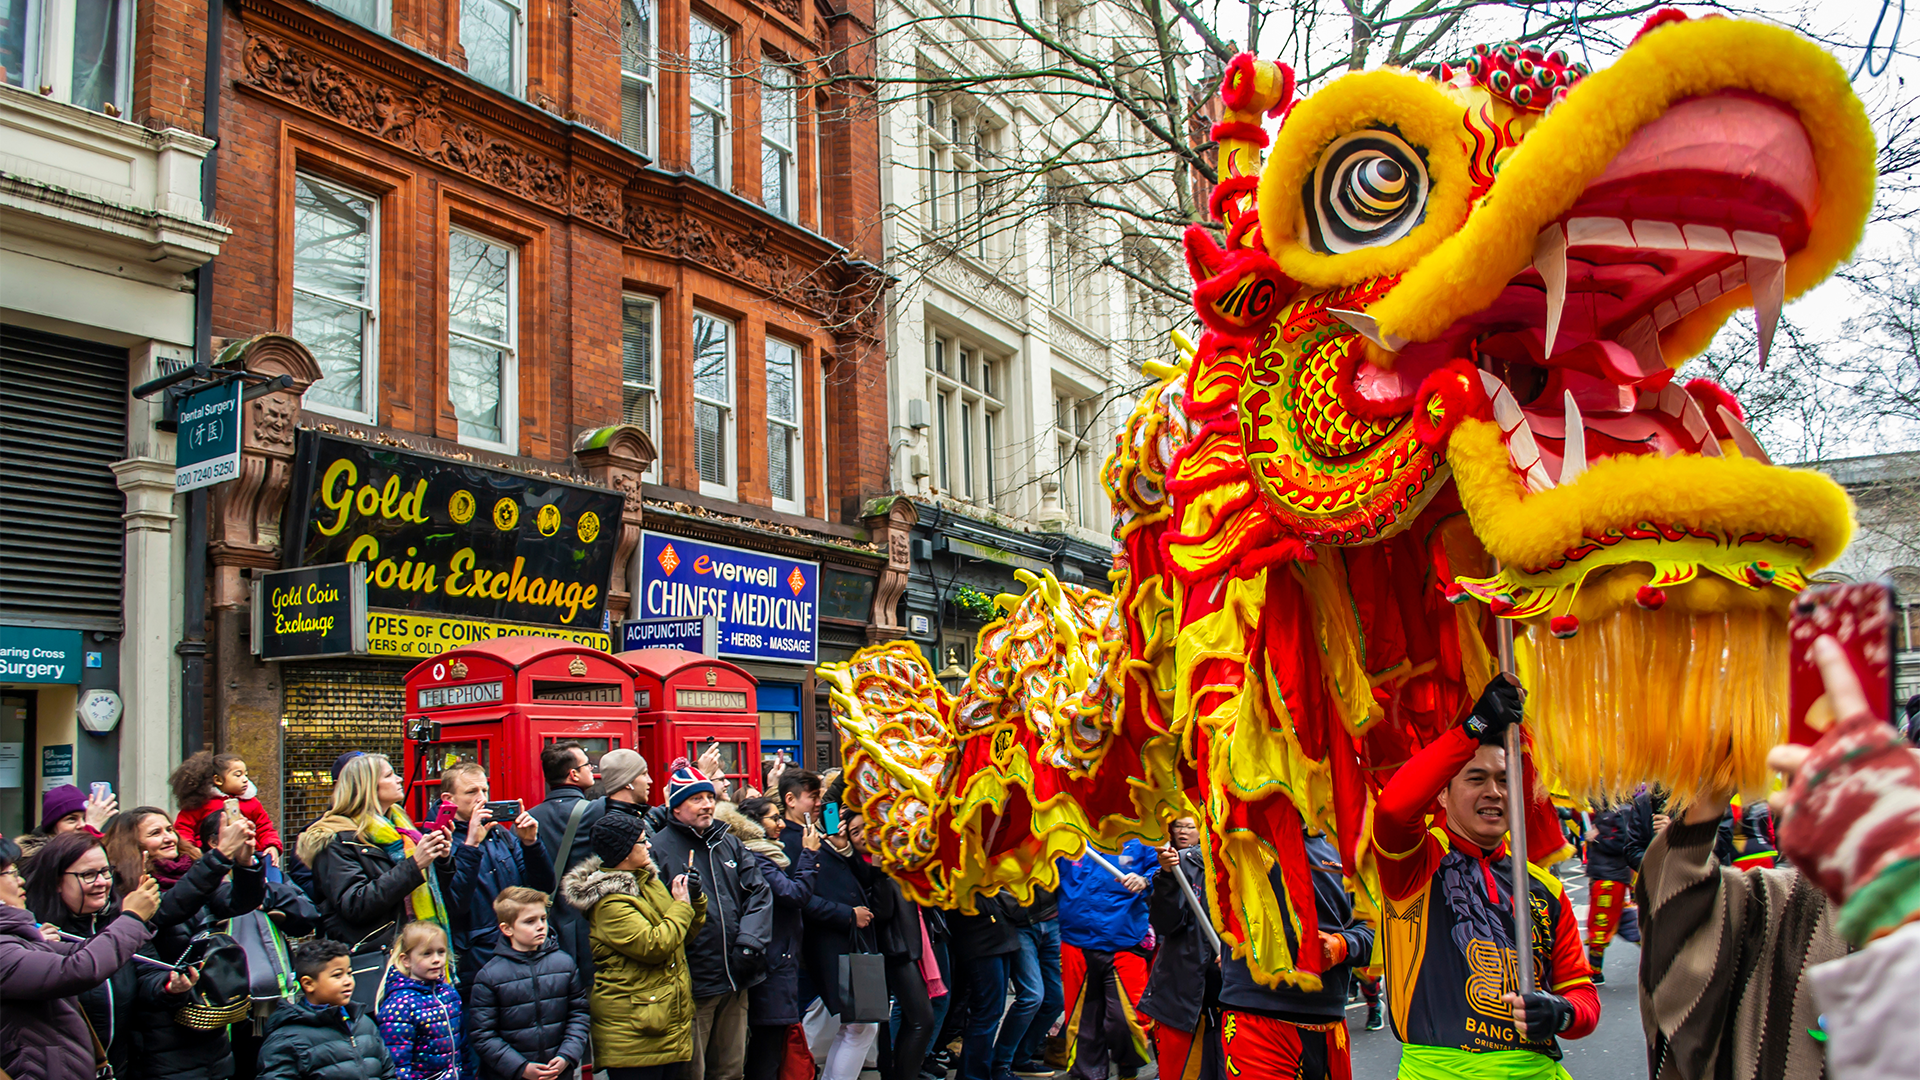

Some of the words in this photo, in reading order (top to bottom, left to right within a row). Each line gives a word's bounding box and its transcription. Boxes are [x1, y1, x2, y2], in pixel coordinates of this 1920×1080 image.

[180, 405, 204, 424] Dental
[204, 398, 236, 416] Surgery
[176, 471, 191, 487] 020
[193, 466, 213, 483] 7240
[213, 460, 235, 477] 5250
[317, 457, 429, 537] Gold
[345, 534, 438, 593] Coin
[444, 547, 599, 624] Exchange
[693, 554, 777, 588] everwell
[272, 586, 302, 617] Gold
[306, 582, 339, 604] Coin
[647, 579, 727, 622] CHINESE
[730, 591, 812, 632] MEDICINE
[275, 612, 335, 638] Exchange
[414, 624, 433, 638] OF
[439, 622, 491, 643] COINS
[572, 634, 609, 653] SOLD
[626, 621, 702, 641] ACUPUNCTURE
[0, 647, 30, 660] aring
[32, 647, 66, 659] Cross
[401, 641, 415, 653] of
[418, 642, 443, 654] OLD
[731, 632, 762, 649] HERBS
[769, 636, 811, 653] MASSAGE
[0, 658, 66, 679] Surgery
[422, 683, 500, 706] TELEPHONE
[679, 692, 743, 708] TELEPHONE
[1465, 1017, 1514, 1042] BANG
[1474, 1037, 1511, 1051] ORIENTAL
